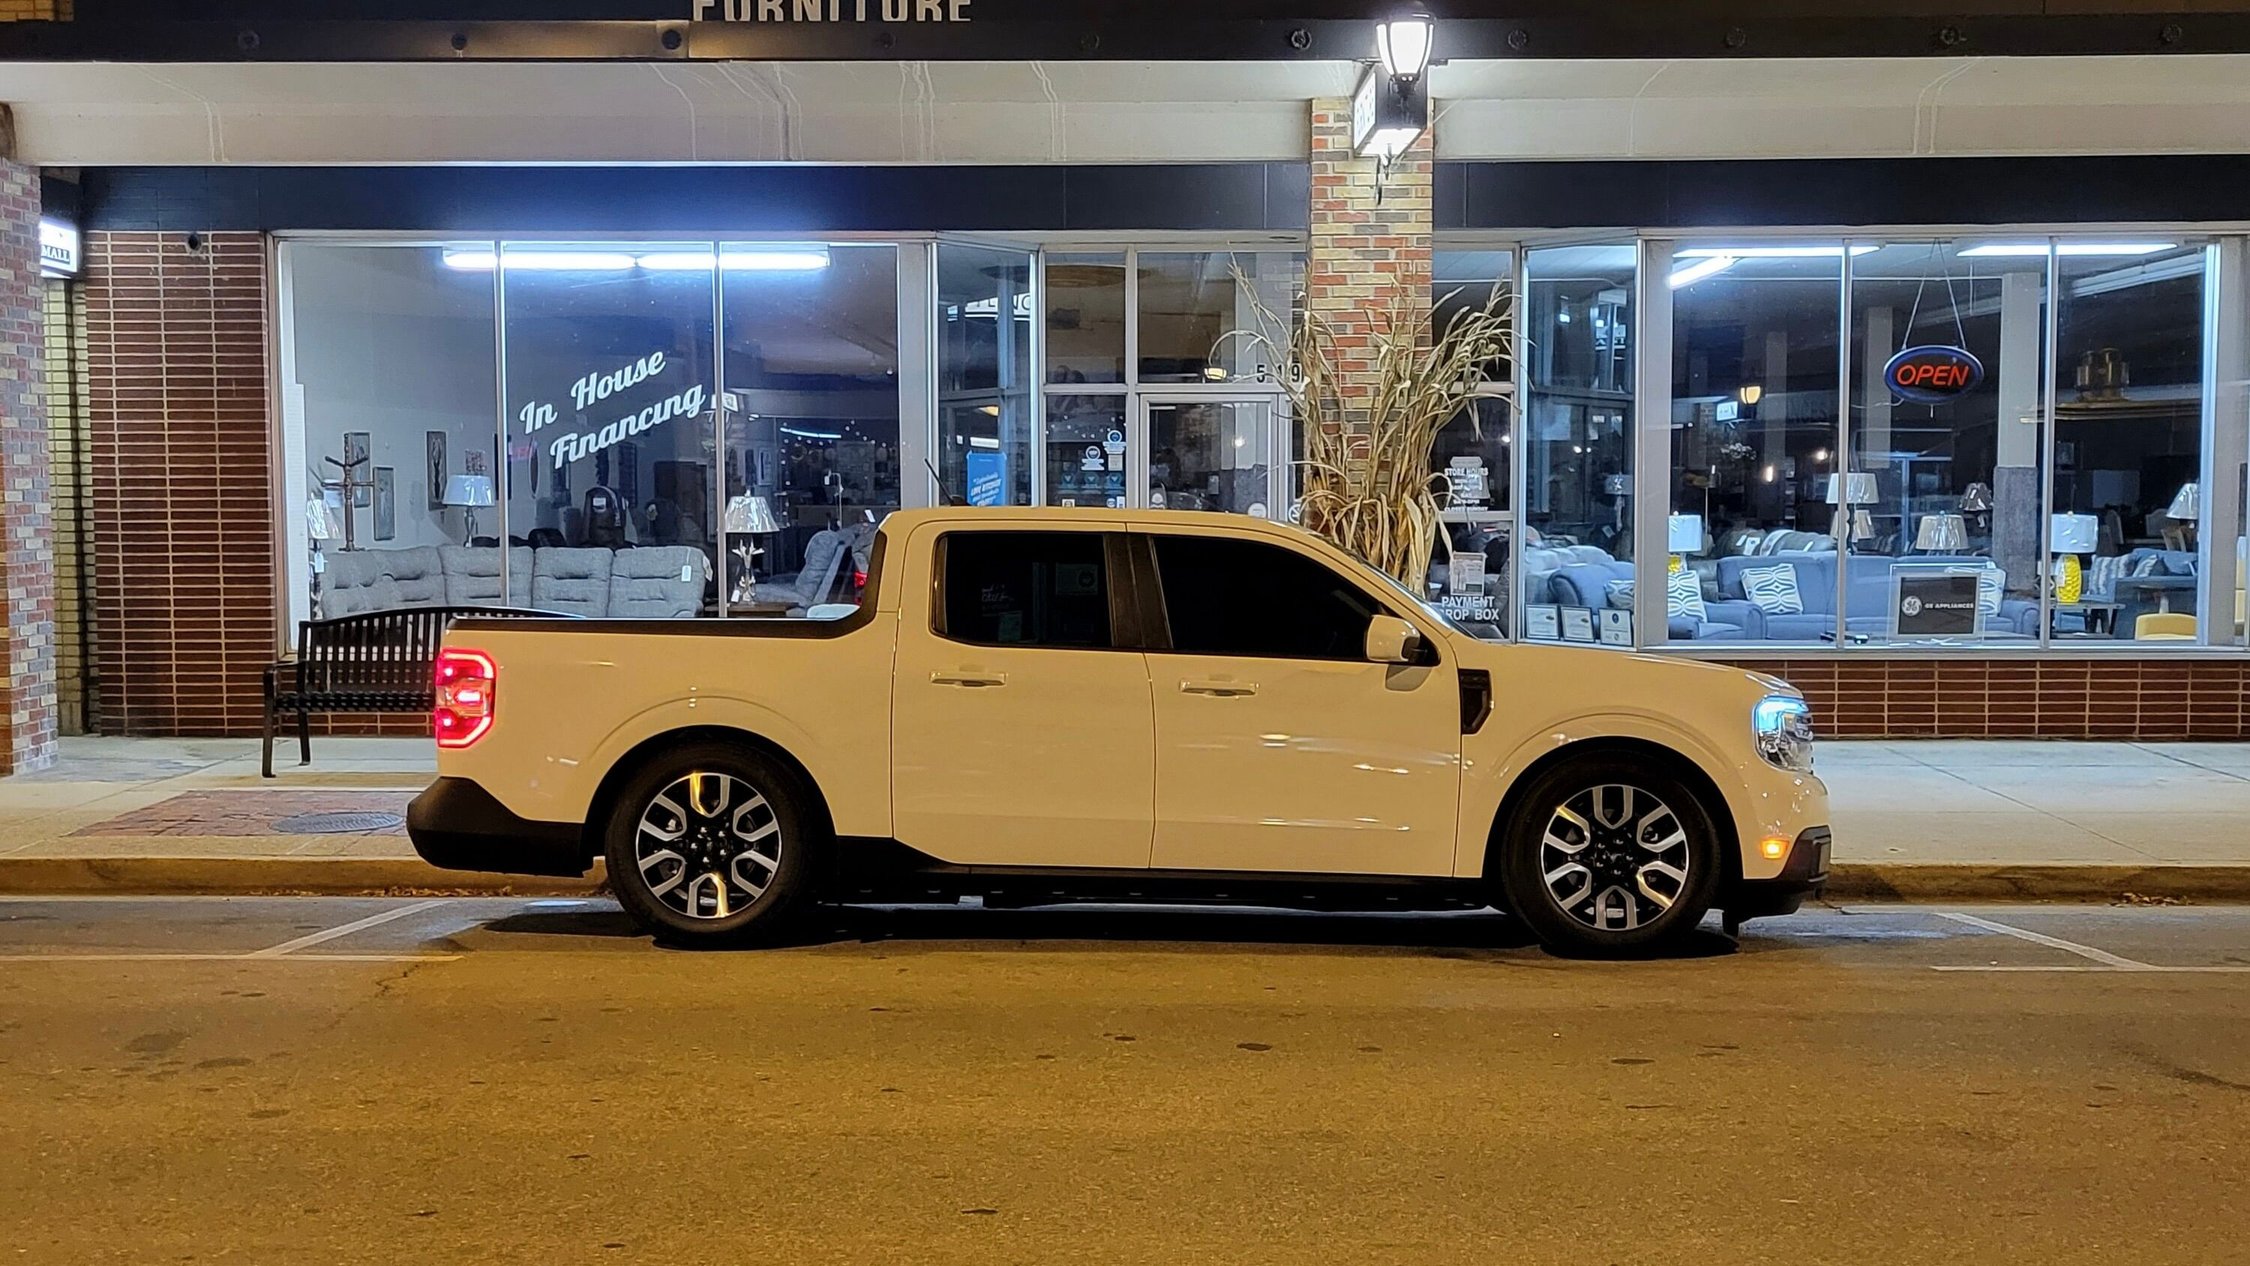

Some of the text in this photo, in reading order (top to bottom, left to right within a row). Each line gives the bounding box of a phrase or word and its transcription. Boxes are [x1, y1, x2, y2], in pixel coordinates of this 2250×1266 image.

[692, 0, 971, 22] FURNITURE
[1896, 364, 1970, 386] OPEN
[519, 351, 667, 434] In House
[550, 384, 706, 470] Financing
[1444, 467, 1489, 477] STORE HOURS
[1441, 596, 1495, 608] PAYMENT
[1440, 608, 1500, 621] ROP BOX
